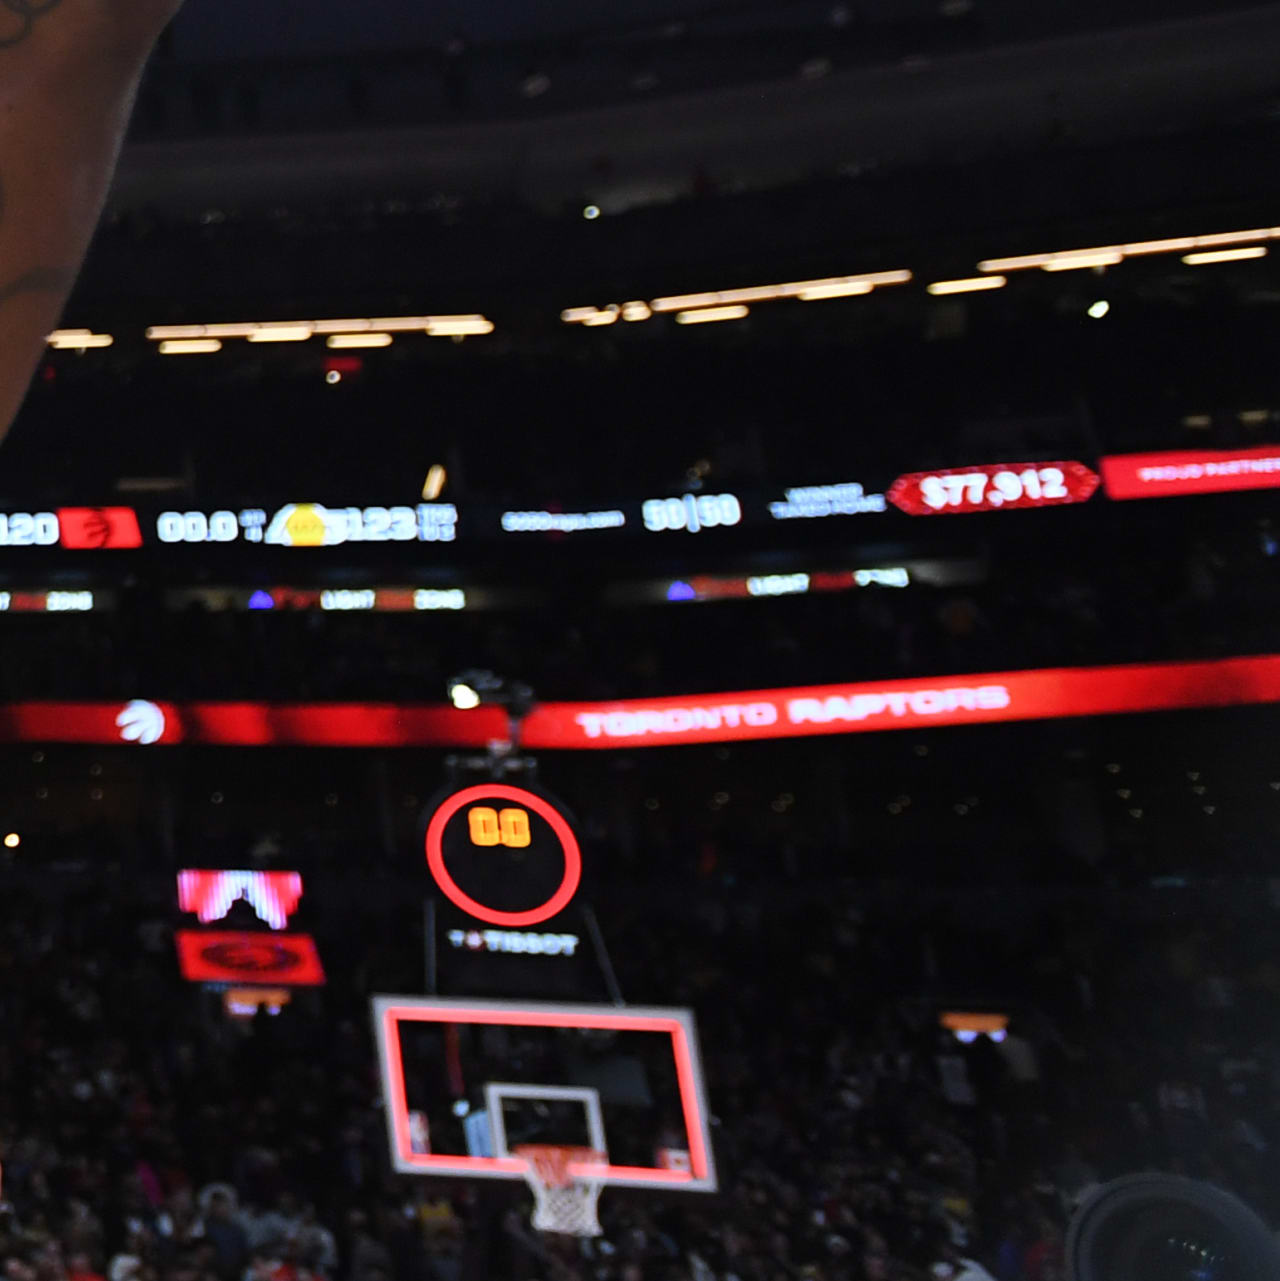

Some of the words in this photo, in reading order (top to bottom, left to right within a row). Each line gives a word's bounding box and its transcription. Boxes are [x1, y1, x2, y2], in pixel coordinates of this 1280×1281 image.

[157, 510, 239, 543] 00.0
[576, 701, 778, 738] TORONTO
[788, 686, 1011, 725] RAPTORS
[468, 806, 531, 848] 00
